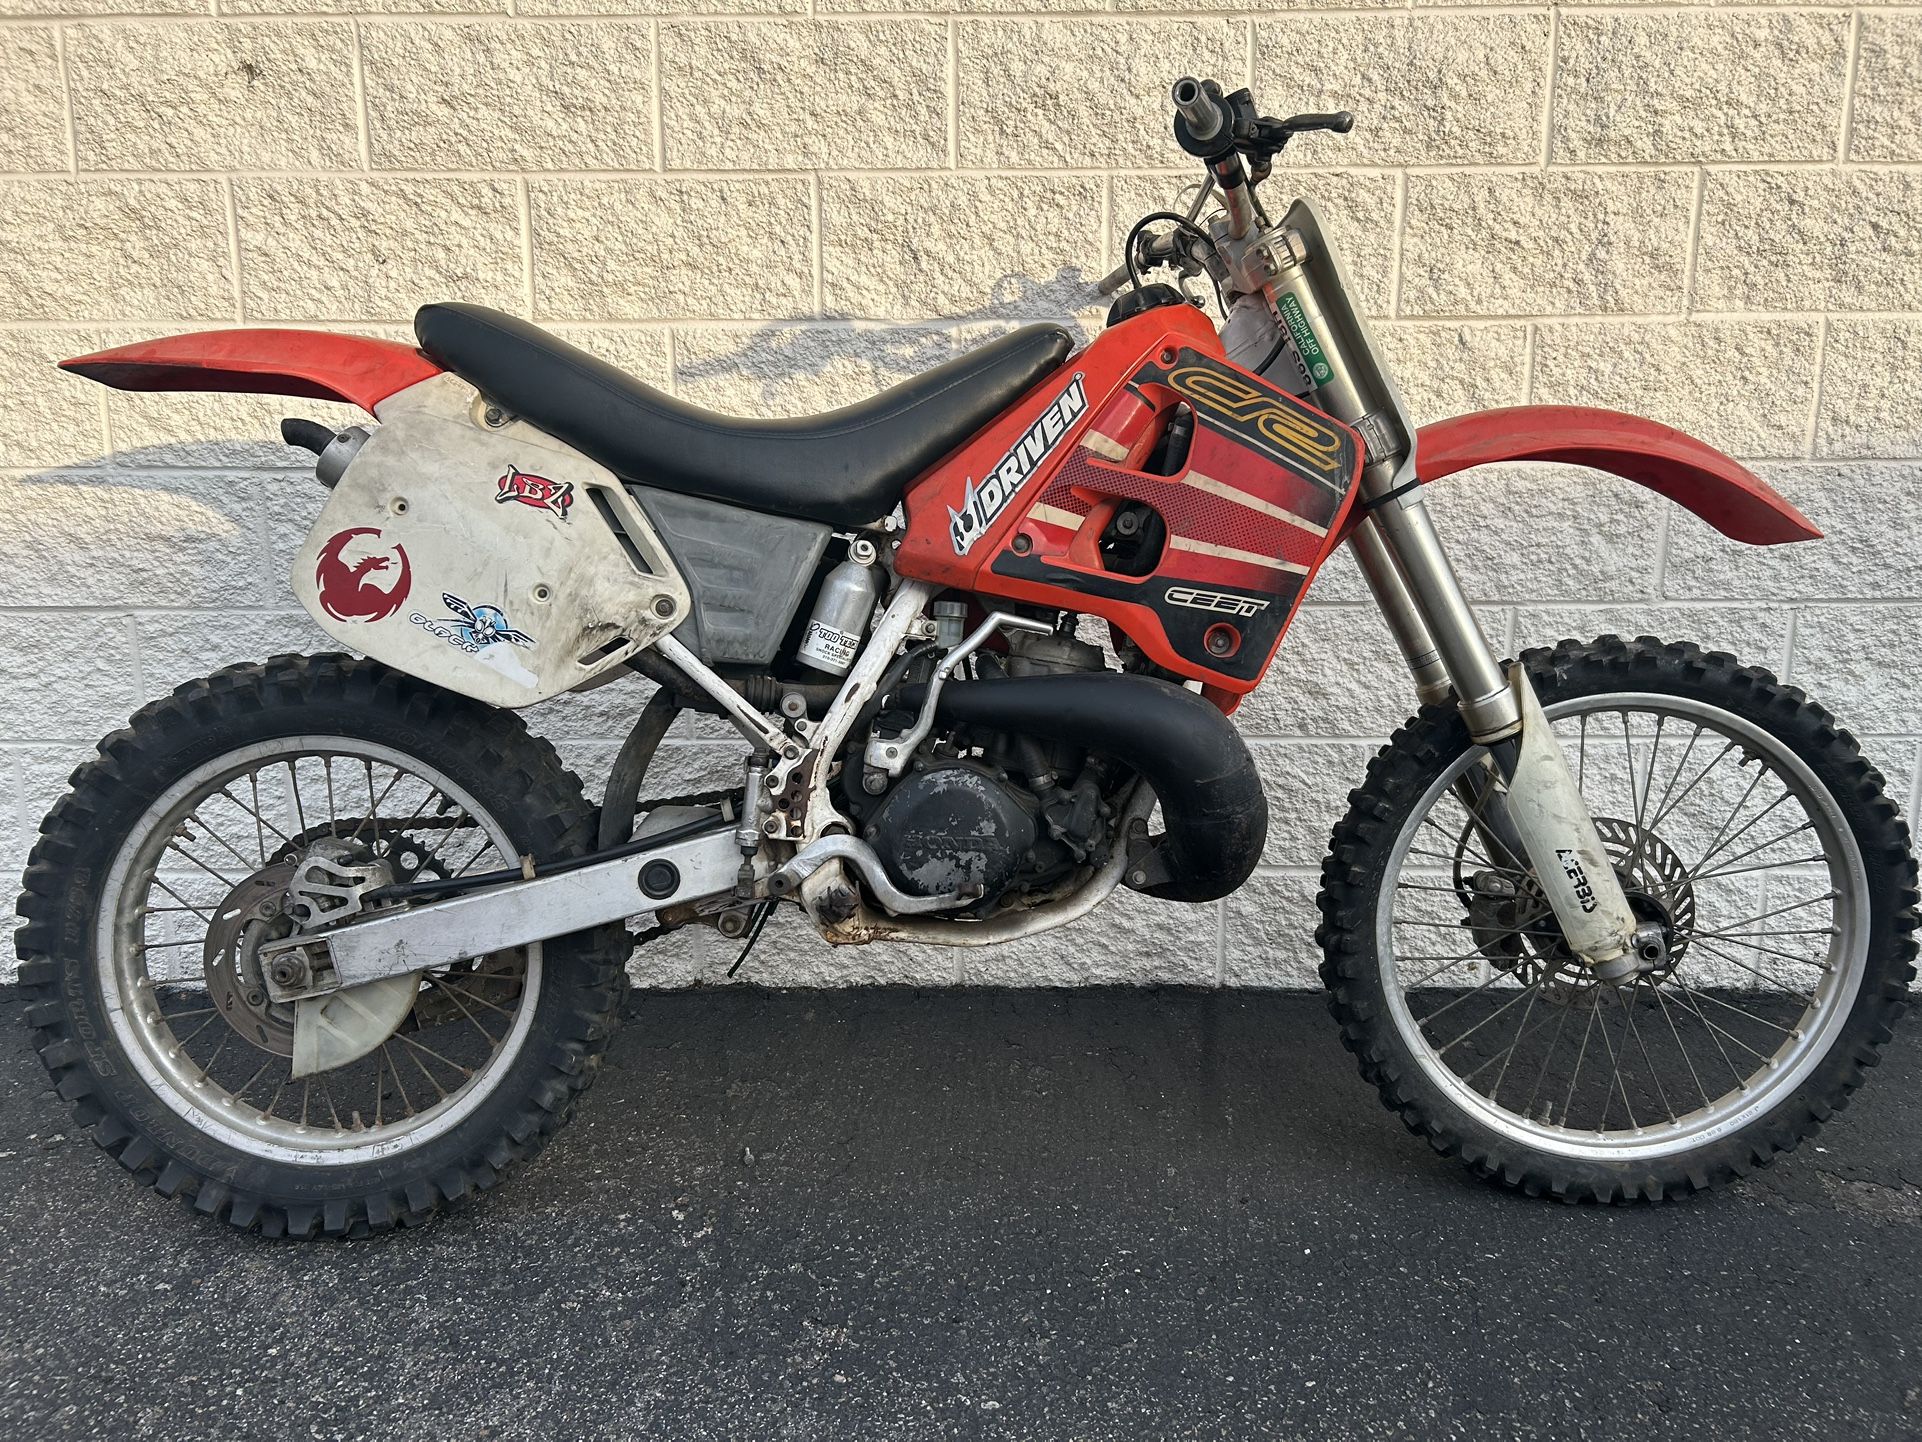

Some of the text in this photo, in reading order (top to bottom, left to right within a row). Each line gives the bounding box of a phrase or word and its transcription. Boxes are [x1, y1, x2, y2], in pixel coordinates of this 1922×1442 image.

[1281, 303, 1310, 356] CALIFORNIA
[1285, 297, 1320, 355] OFF HIGHWAY
[978, 385, 1087, 517] DRIVEN
[824, 643, 850, 657] RACING
